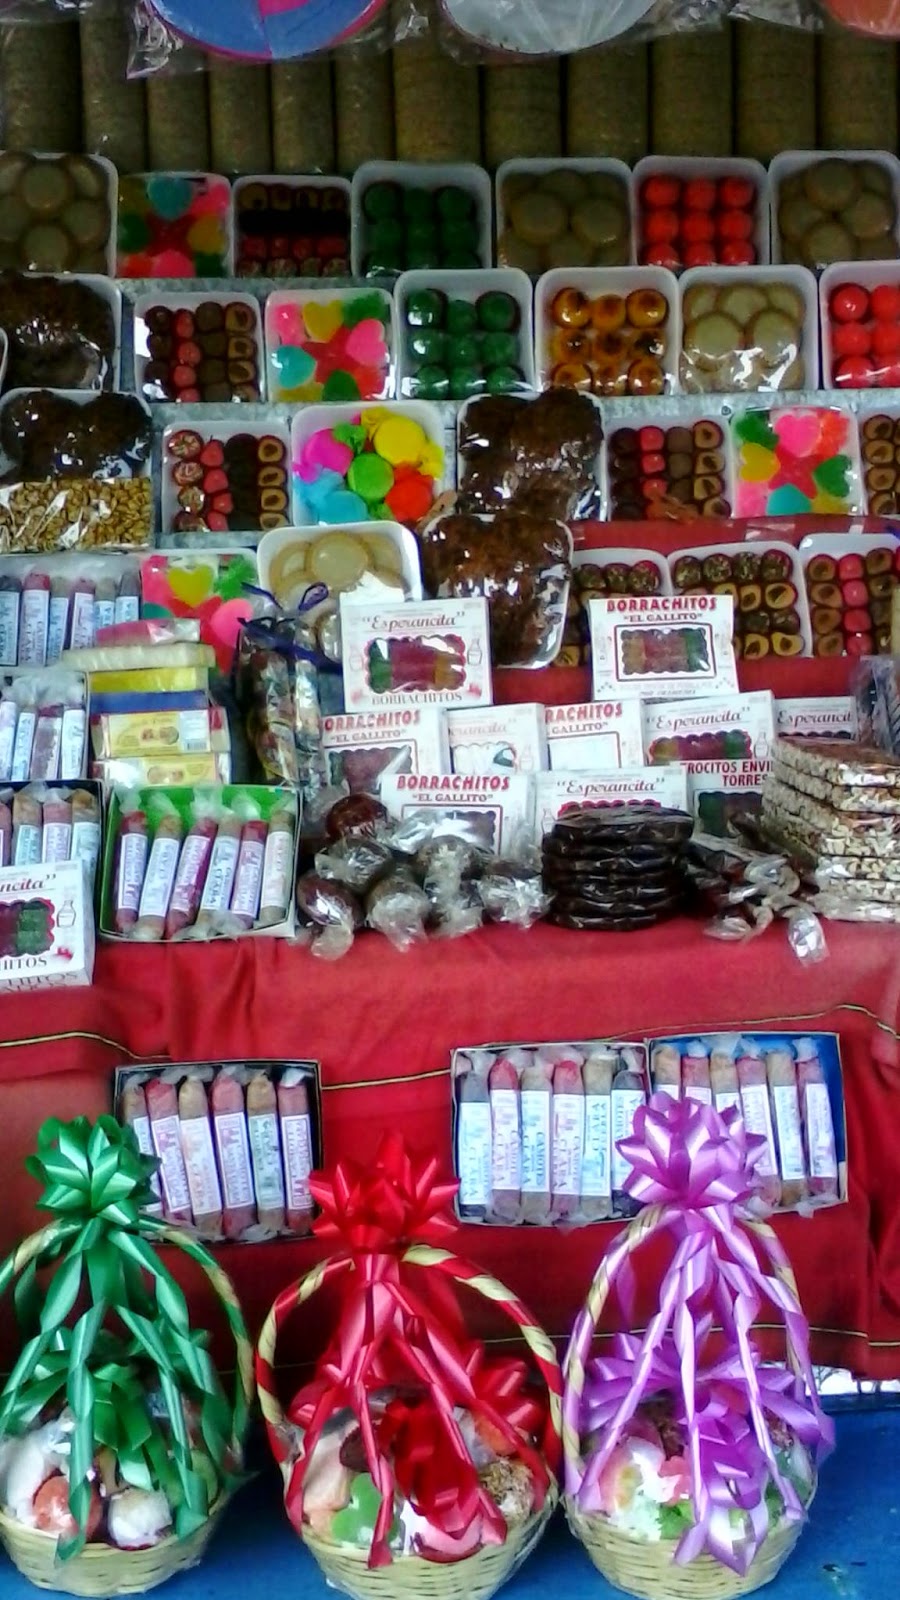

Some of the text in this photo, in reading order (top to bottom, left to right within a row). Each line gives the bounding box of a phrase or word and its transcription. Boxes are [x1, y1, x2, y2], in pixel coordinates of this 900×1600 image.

[606, 596, 718, 613] BORRACHITOS
[324, 709, 421, 732] ORRACHITOS
[545, 702, 624, 723] RACHITOS
[680, 760, 773, 775] ROCITOS ENVI
[397, 775, 510, 790] BORRACHITOS
